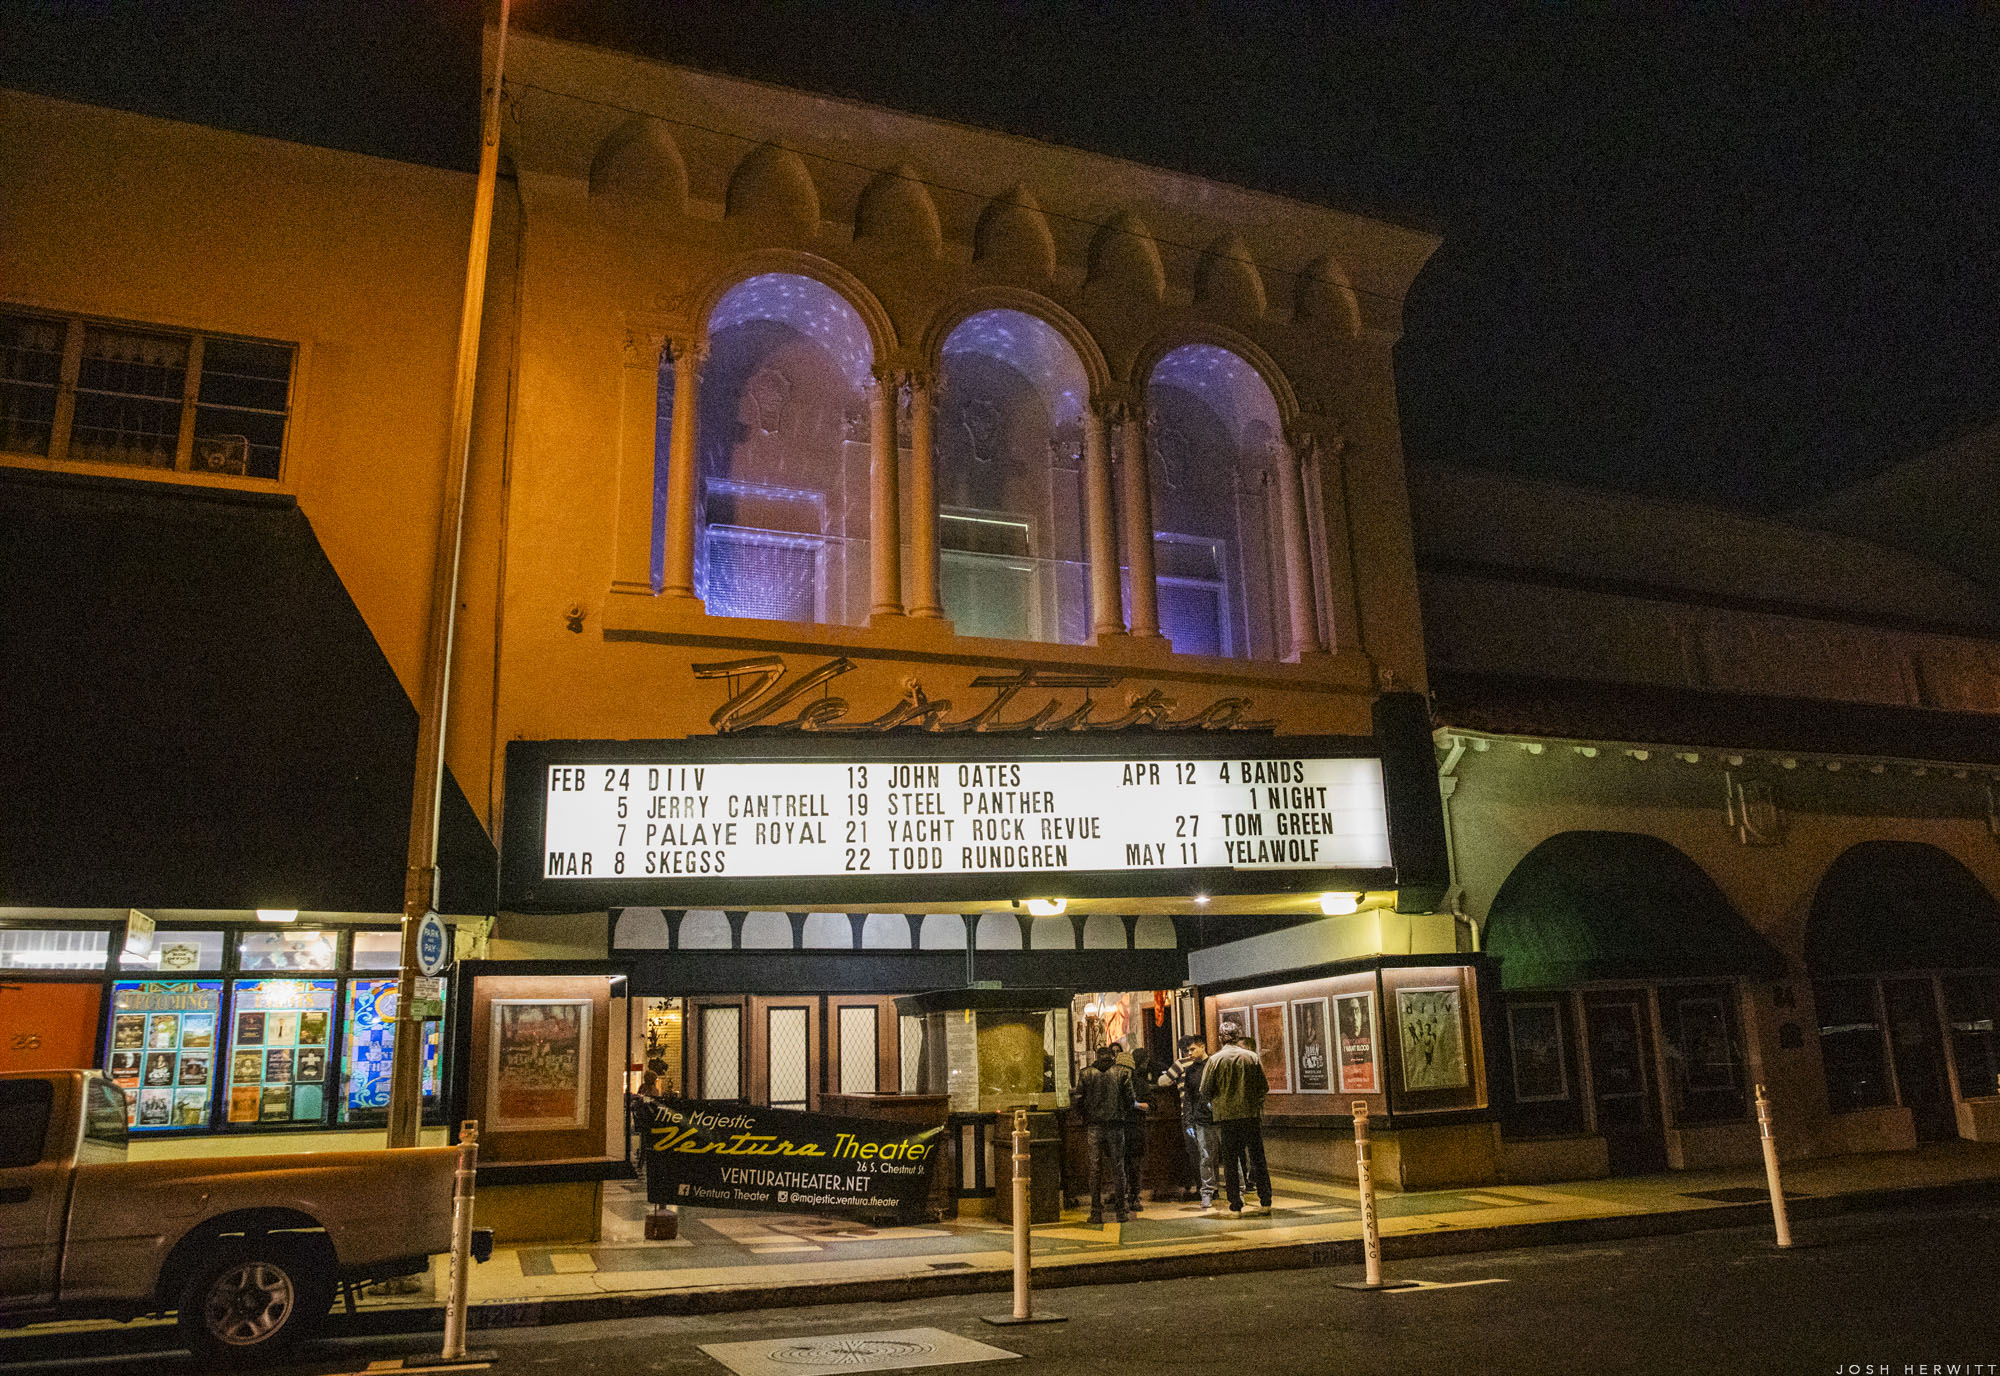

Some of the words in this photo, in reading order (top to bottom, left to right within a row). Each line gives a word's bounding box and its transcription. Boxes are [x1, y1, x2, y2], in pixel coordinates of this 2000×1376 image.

[552, 768, 585, 792] FEB
[604, 768, 630, 791] 24
[649, 767, 705, 791] DIIV
[847, 766, 868, 788] 13
[888, 765, 939, 788] JOHN
[958, 764, 1021, 787] OATES
[1122, 764, 1160, 786] APR
[1176, 763, 1197, 785] 12
[1219, 762, 1231, 783] 4
[1241, 761, 1304, 783] BANDS
[618, 797, 627, 818] 5
[647, 796, 707, 818] JERRY
[729, 795, 828, 817] CANTRELL
[848, 794, 867, 815] 19
[888, 793, 945, 815] STEEL
[964, 792, 1053, 814] PANTHER
[1250, 788, 1257, 809] 1
[1268, 787, 1325, 809] NIGHT
[619, 824, 625, 846] 7
[647, 823, 736, 845] PALAYE
[757, 822, 825, 844] ROYAL
[847, 821, 865, 843] 21
[888, 820, 955, 842] YACHT
[973, 819, 1024, 840] ROCK
[1041, 817, 1102, 839] REVUE
[1176, 815, 1198, 837] 27
[1222, 813, 1262, 836] TOM
[1277, 813, 1333, 835] GREEN
[549, 852, 593, 875] MAR
[615, 852, 624, 874] 8
[645, 850, 726, 874] SKEGSS
[846, 848, 870, 870] 22
[889, 847, 941, 870] TODD
[962, 845, 1068, 869] RUNDGREN
[1127, 843, 1166, 865] MAY
[1181, 842, 1197, 864] 11
[1225, 840, 1320, 863] YELAWOLF
[654, 1106, 684, 1124] The
[688, 1111, 756, 1130] Majestic
[651, 1126, 827, 1157] Ventura
[832, 1133, 934, 1161] Theater
[720, 1166, 871, 1192] VENTURATHEATER.NET
[856, 1160, 868, 1172] 26
[870, 1161, 878, 1173] S.
[880, 1162, 916, 1174] Chestnut
[1363, 1164, 1371, 1182] NO
[693, 1184, 731, 1200] Ventura
[734, 1187, 770, 1202] Theater
[789, 1190, 900, 1208] @majestic.ventura.theater
[1364, 1192, 1378, 1260] PARKING
